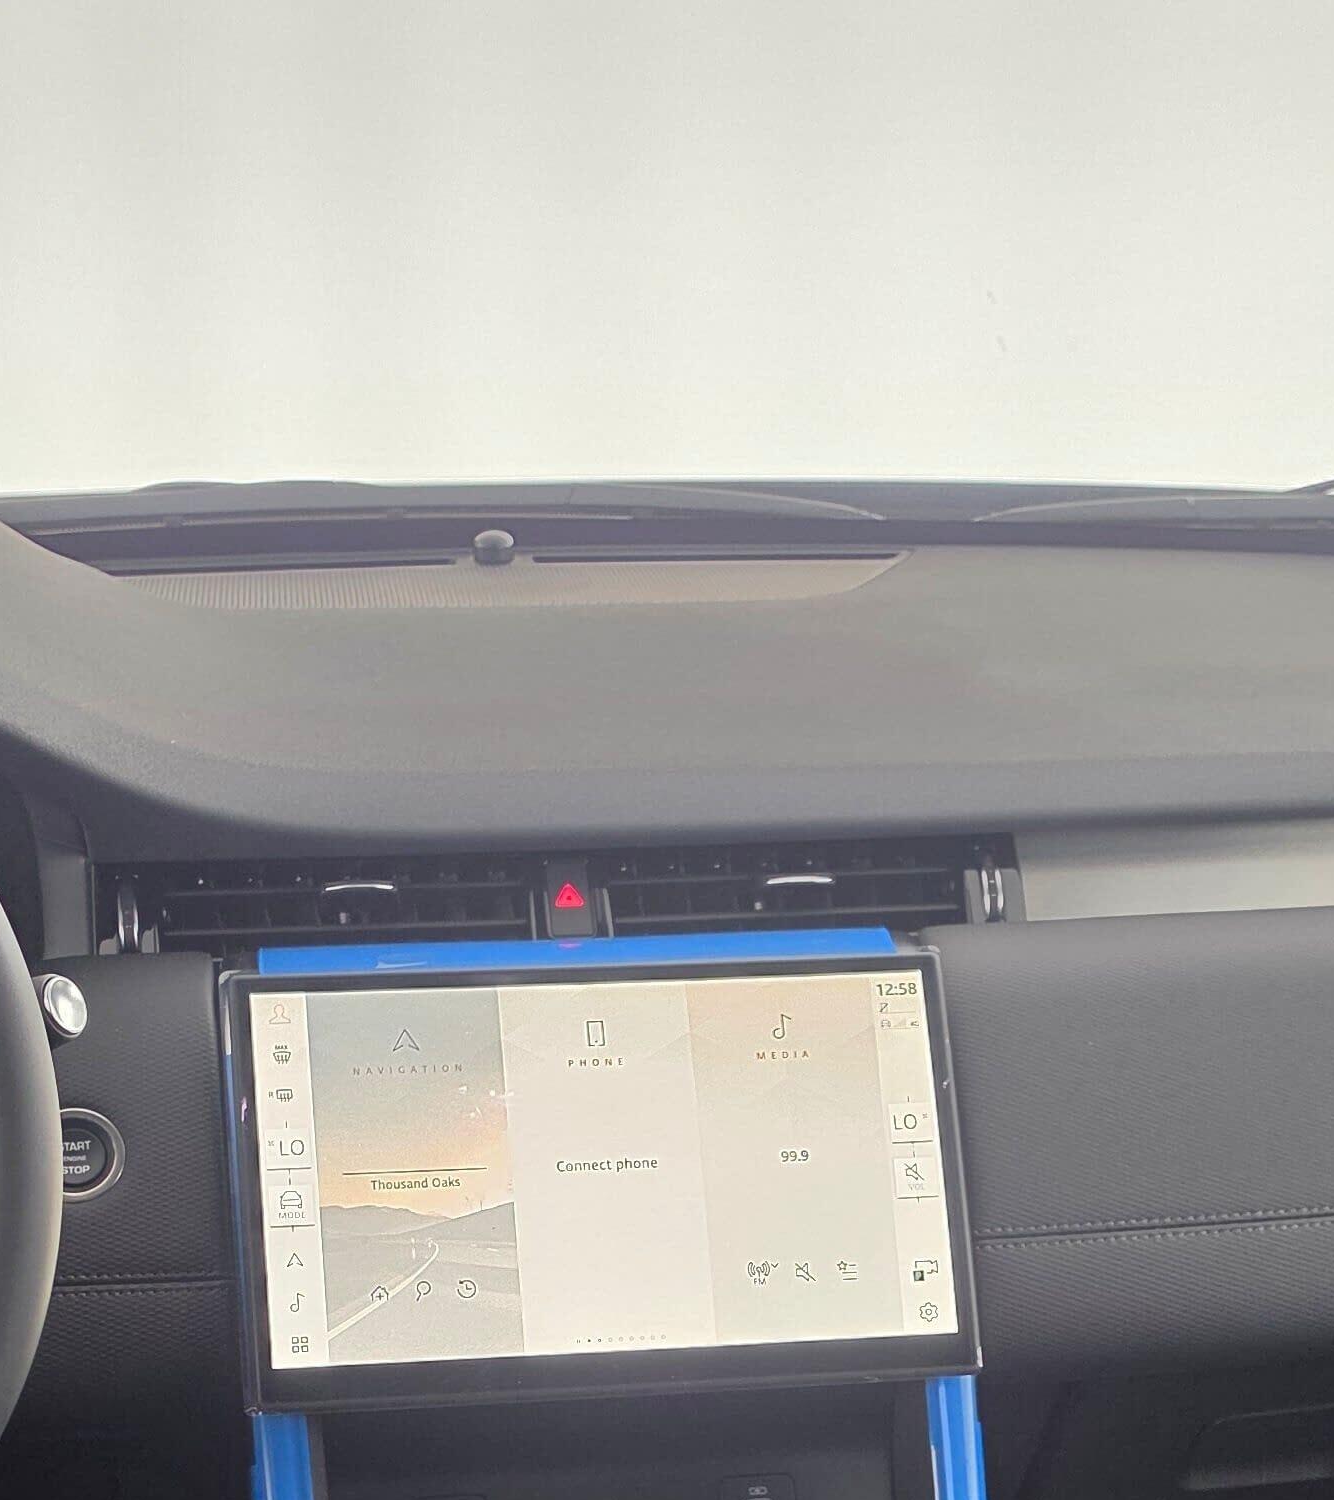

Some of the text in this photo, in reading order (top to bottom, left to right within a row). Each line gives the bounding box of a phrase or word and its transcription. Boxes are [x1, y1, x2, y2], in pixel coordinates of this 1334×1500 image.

[876, 982, 918, 997] 12:58
[756, 1050, 809, 1060] MEDIA
[568, 1058, 624, 1067] PHONE
[353, 1063, 463, 1076] NAVIGATION
[893, 1113, 917, 1130] LO
[62, 1140, 92, 1152] TART
[279, 1139, 305, 1156] LO
[780, 1150, 809, 1162] 99.9
[63, 1165, 91, 1175] STOP
[556, 1157, 658, 1173] Connect phone
[371, 1175, 461, 1191] Thousand Oaks
[753, 1278, 767, 1286] FM
